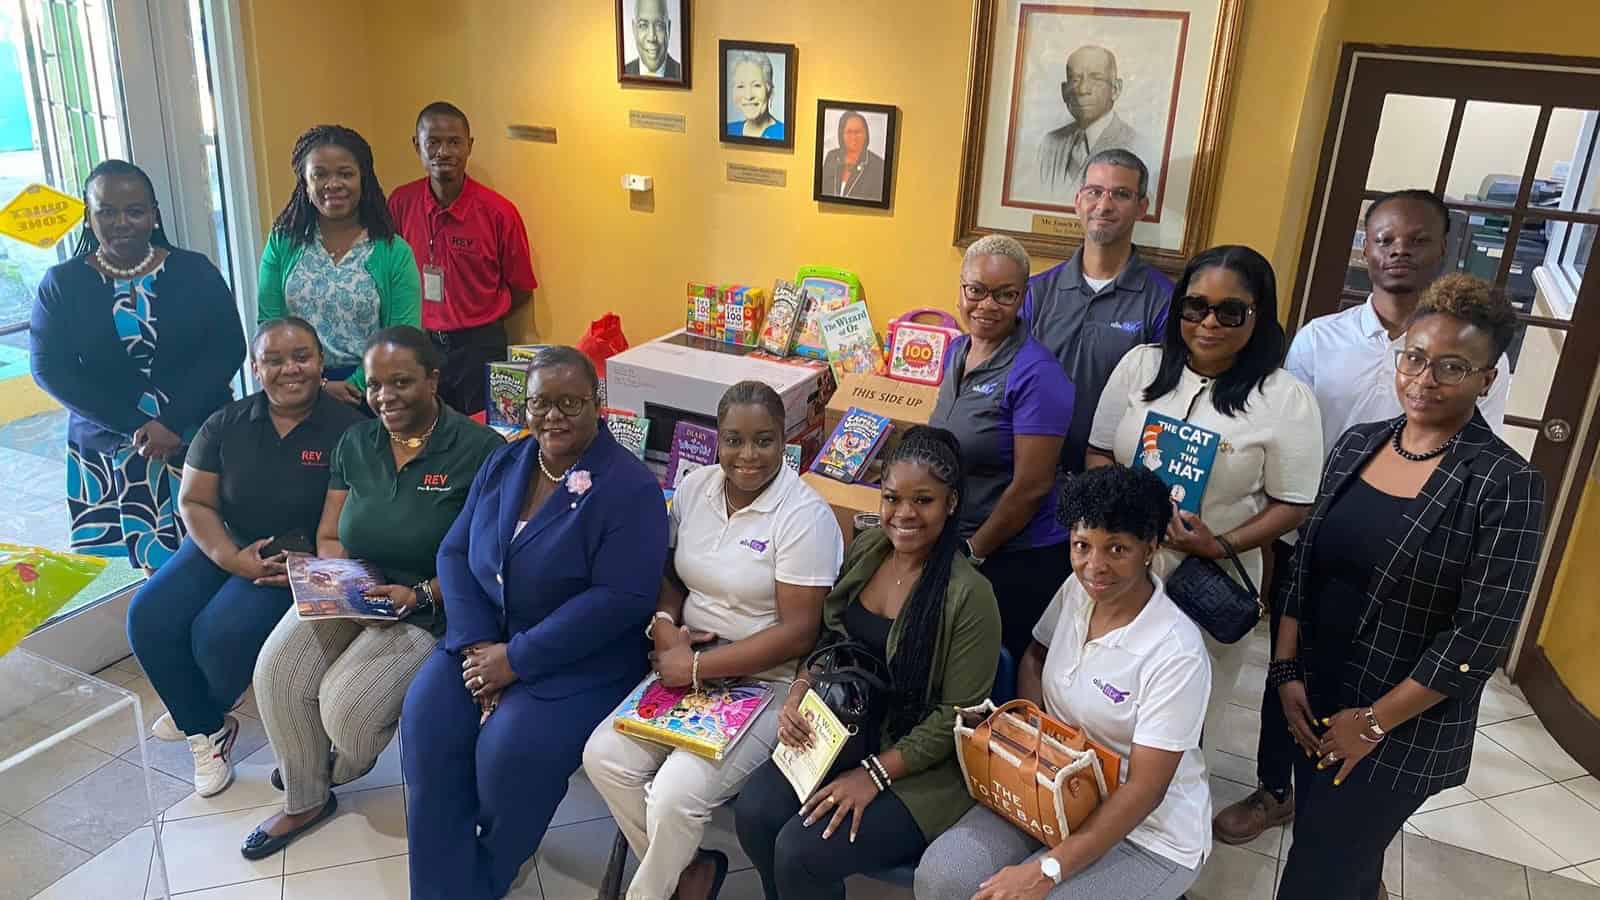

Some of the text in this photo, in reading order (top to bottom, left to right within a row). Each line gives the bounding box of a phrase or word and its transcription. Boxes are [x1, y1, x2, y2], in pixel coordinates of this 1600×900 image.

[726, 312, 742, 321] 100
[835, 310, 867, 327] Wizard
[905, 343, 932, 360] 100
[852, 386, 923, 408] THIS SIDE UP
[1158, 420, 1213, 447] THE CAT
[301, 450, 322, 461] REV
[1185, 444, 1198, 454] IN
[1180, 452, 1199, 465] THE
[423, 473, 449, 485] REV
[1168, 459, 1204, 483] HAT
[992, 779, 1022, 808] THE
[970, 775, 1012, 812] TOTE
[1016, 809, 1054, 836] BAG
